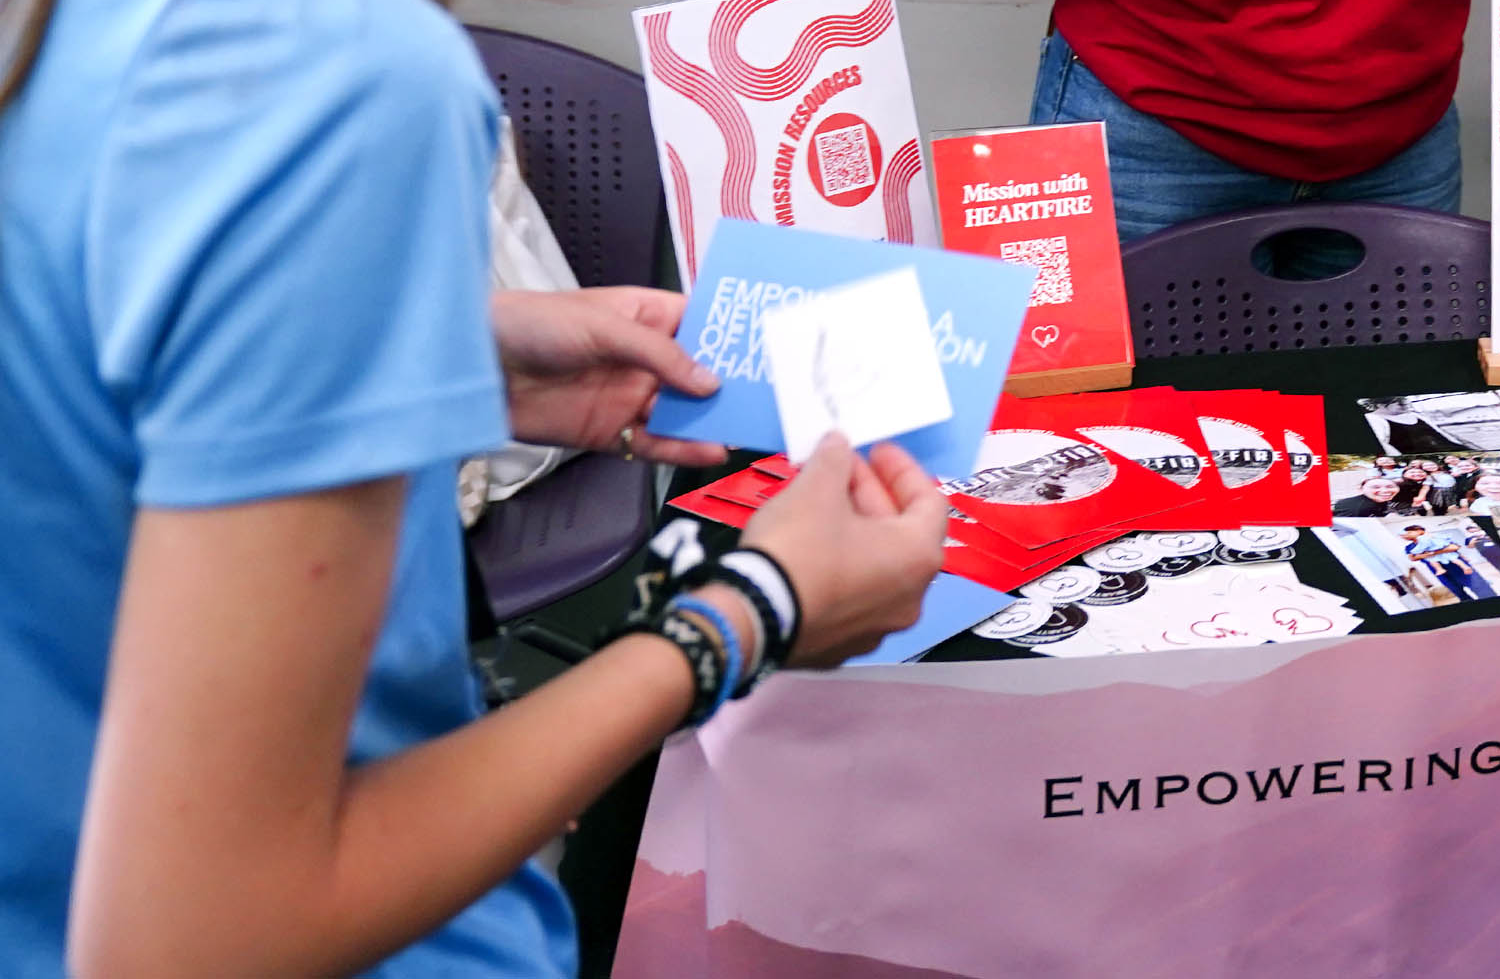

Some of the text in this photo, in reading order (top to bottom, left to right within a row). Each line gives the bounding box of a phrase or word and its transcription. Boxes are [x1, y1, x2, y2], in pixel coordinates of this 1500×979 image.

[772, 64, 863, 227] MISSION RESOURCES
[962, 172, 1089, 204] Mission with
[964, 194, 1093, 228] HEARTFIRE
[714, 276, 813, 310] EMPO
[698, 323, 746, 355] OF
[1052, 442, 1108, 464] FIRE
[1157, 454, 1212, 469] FIRE
[1229, 449, 1284, 462] FIRE
[1293, 450, 1323, 466] RE
